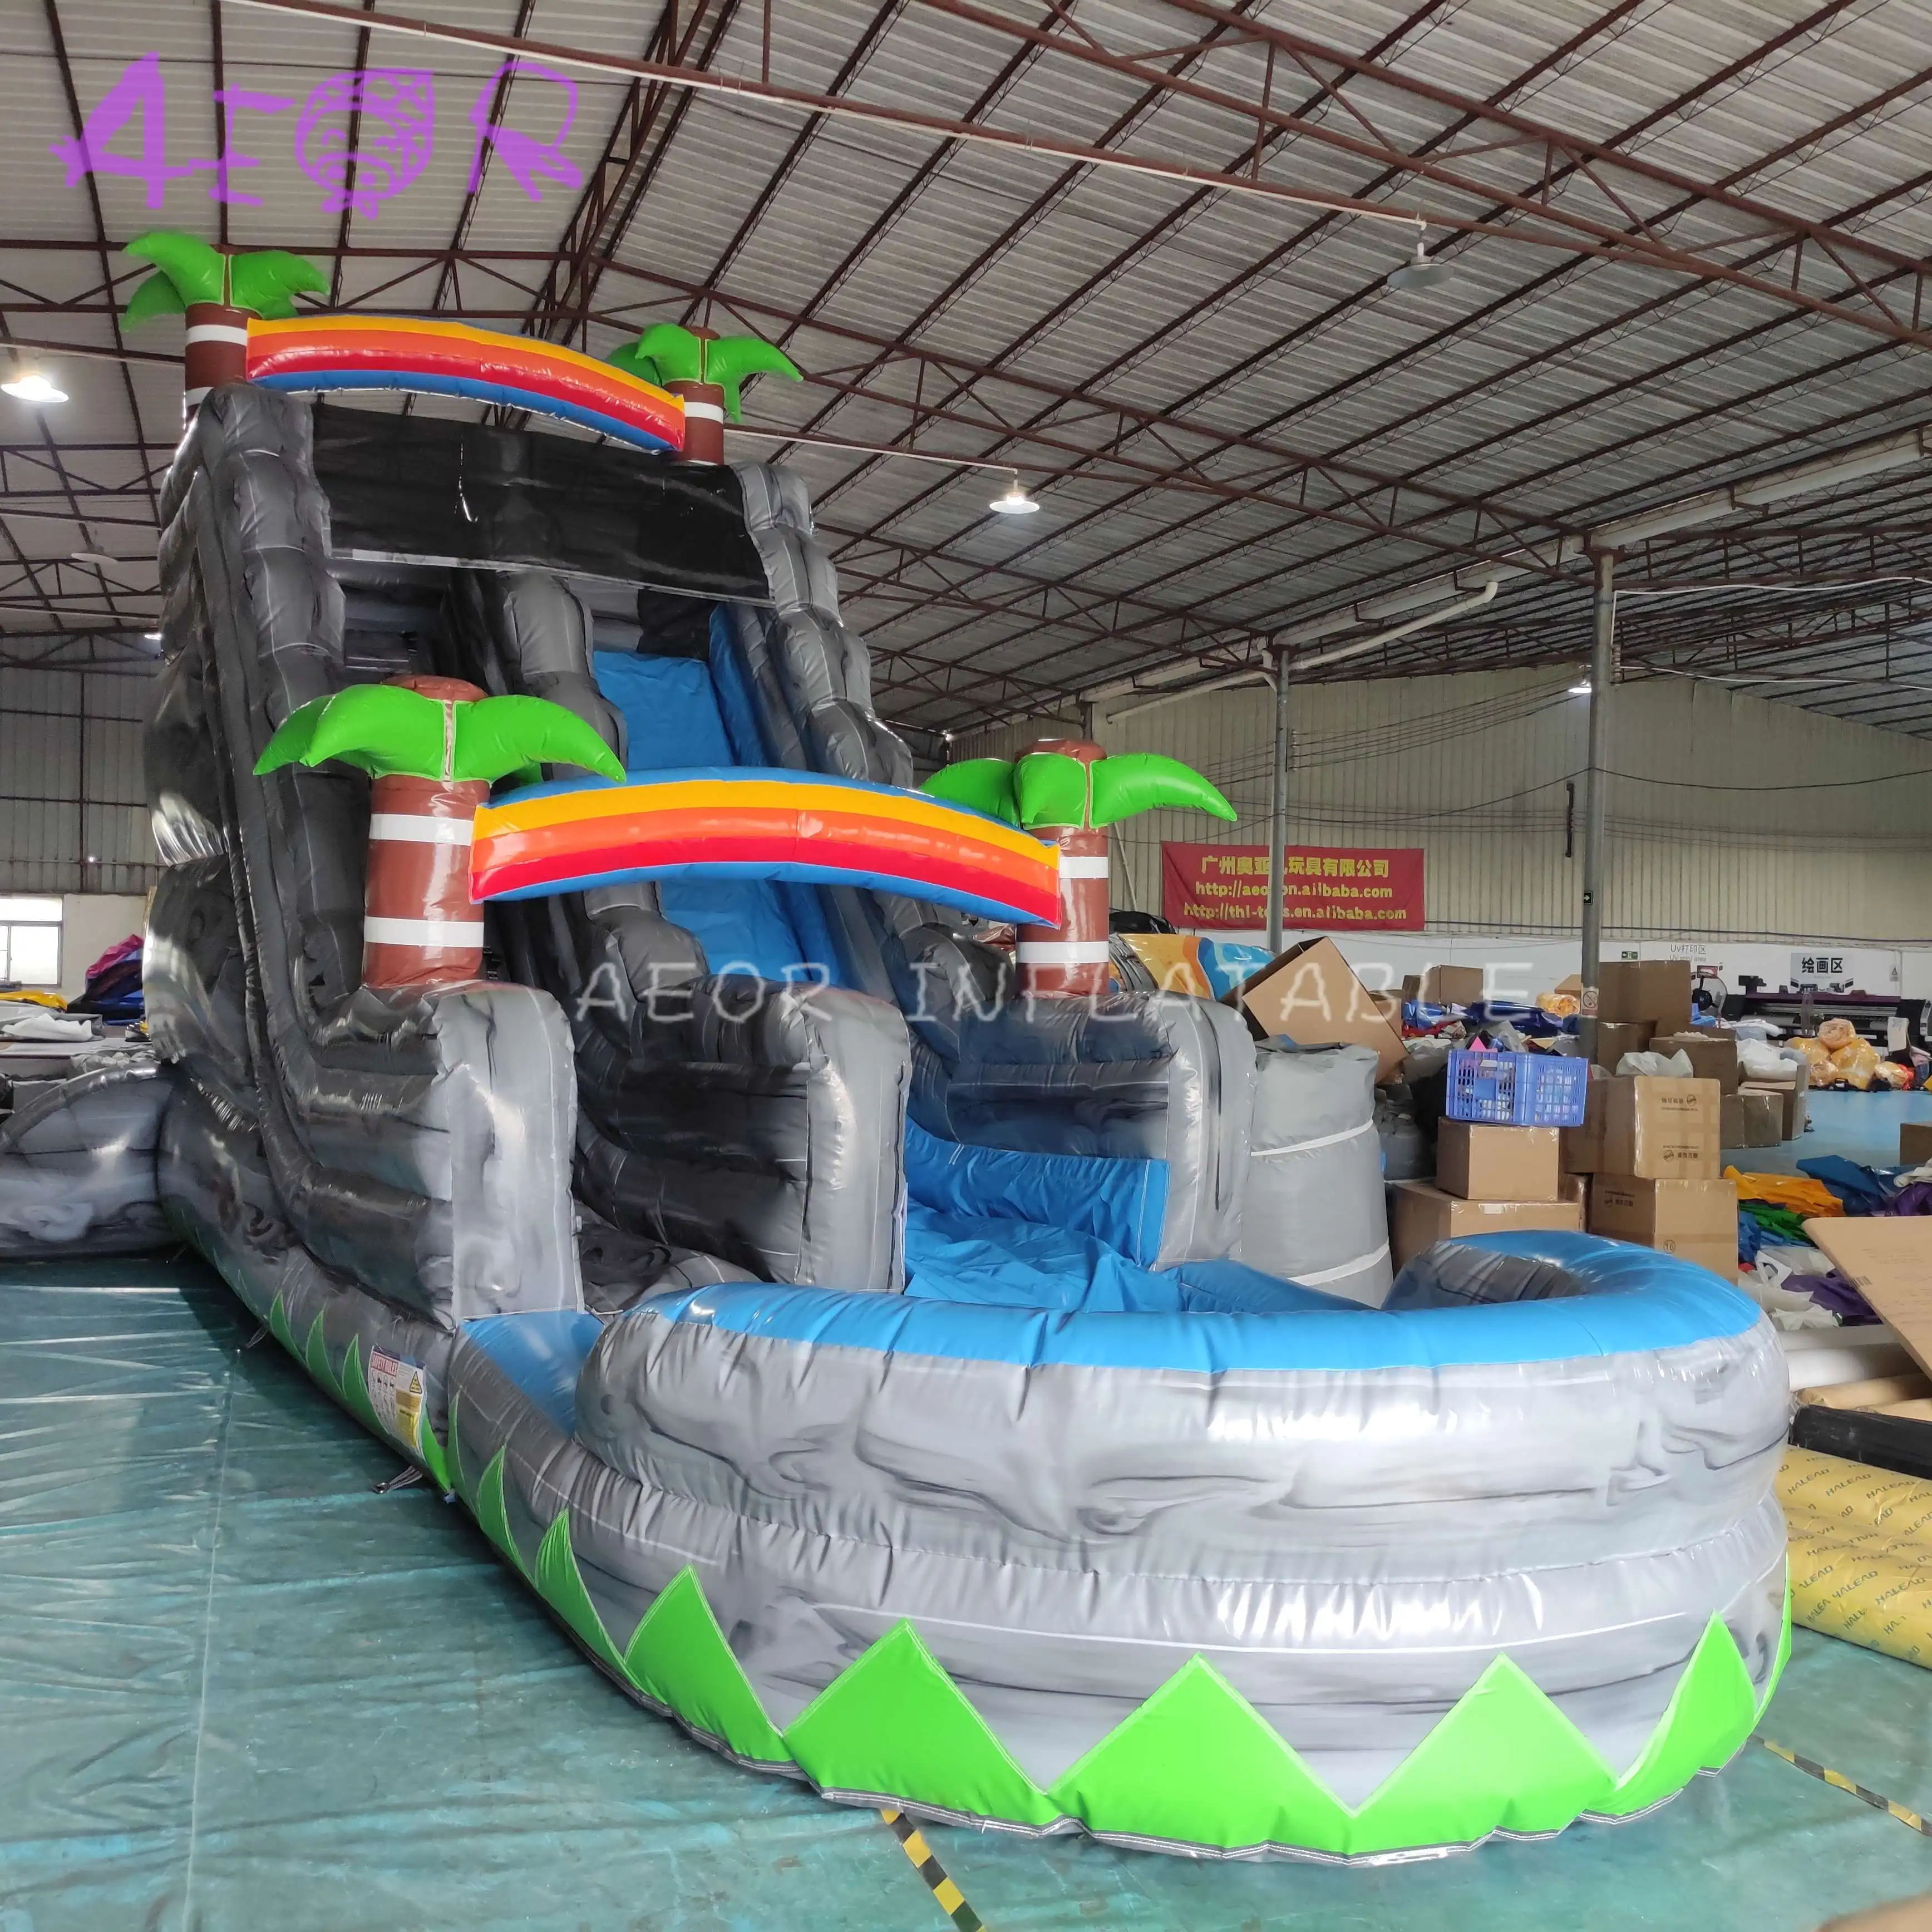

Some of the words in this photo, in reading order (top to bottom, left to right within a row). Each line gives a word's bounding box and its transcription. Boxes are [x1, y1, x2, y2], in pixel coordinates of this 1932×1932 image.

[1201, 855, 1389, 878] 广州奥亚玩具有限公司
[1801, 957, 1844, 973] 绘画区
[1787, 1468, 1830, 1495] HALEAD
[1826, 1473, 1871, 1497] HALEAD
